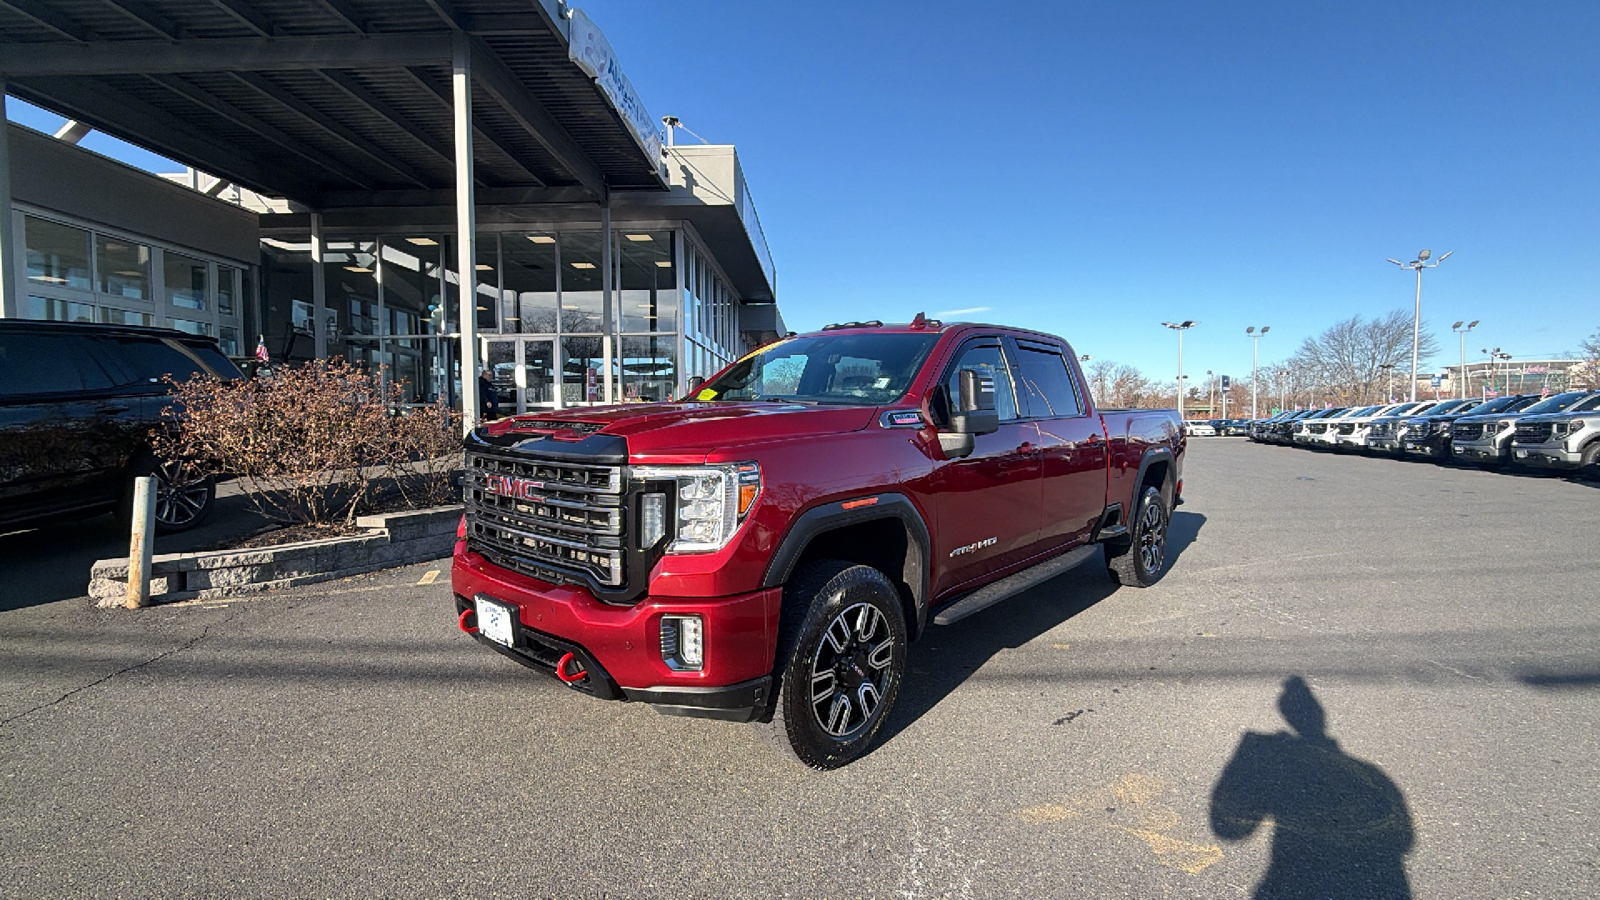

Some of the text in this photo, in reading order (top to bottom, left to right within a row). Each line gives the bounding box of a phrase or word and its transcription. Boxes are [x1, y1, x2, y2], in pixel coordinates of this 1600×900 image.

[485, 474, 545, 502] GMC
[949, 536, 998, 558] AT4 HD
